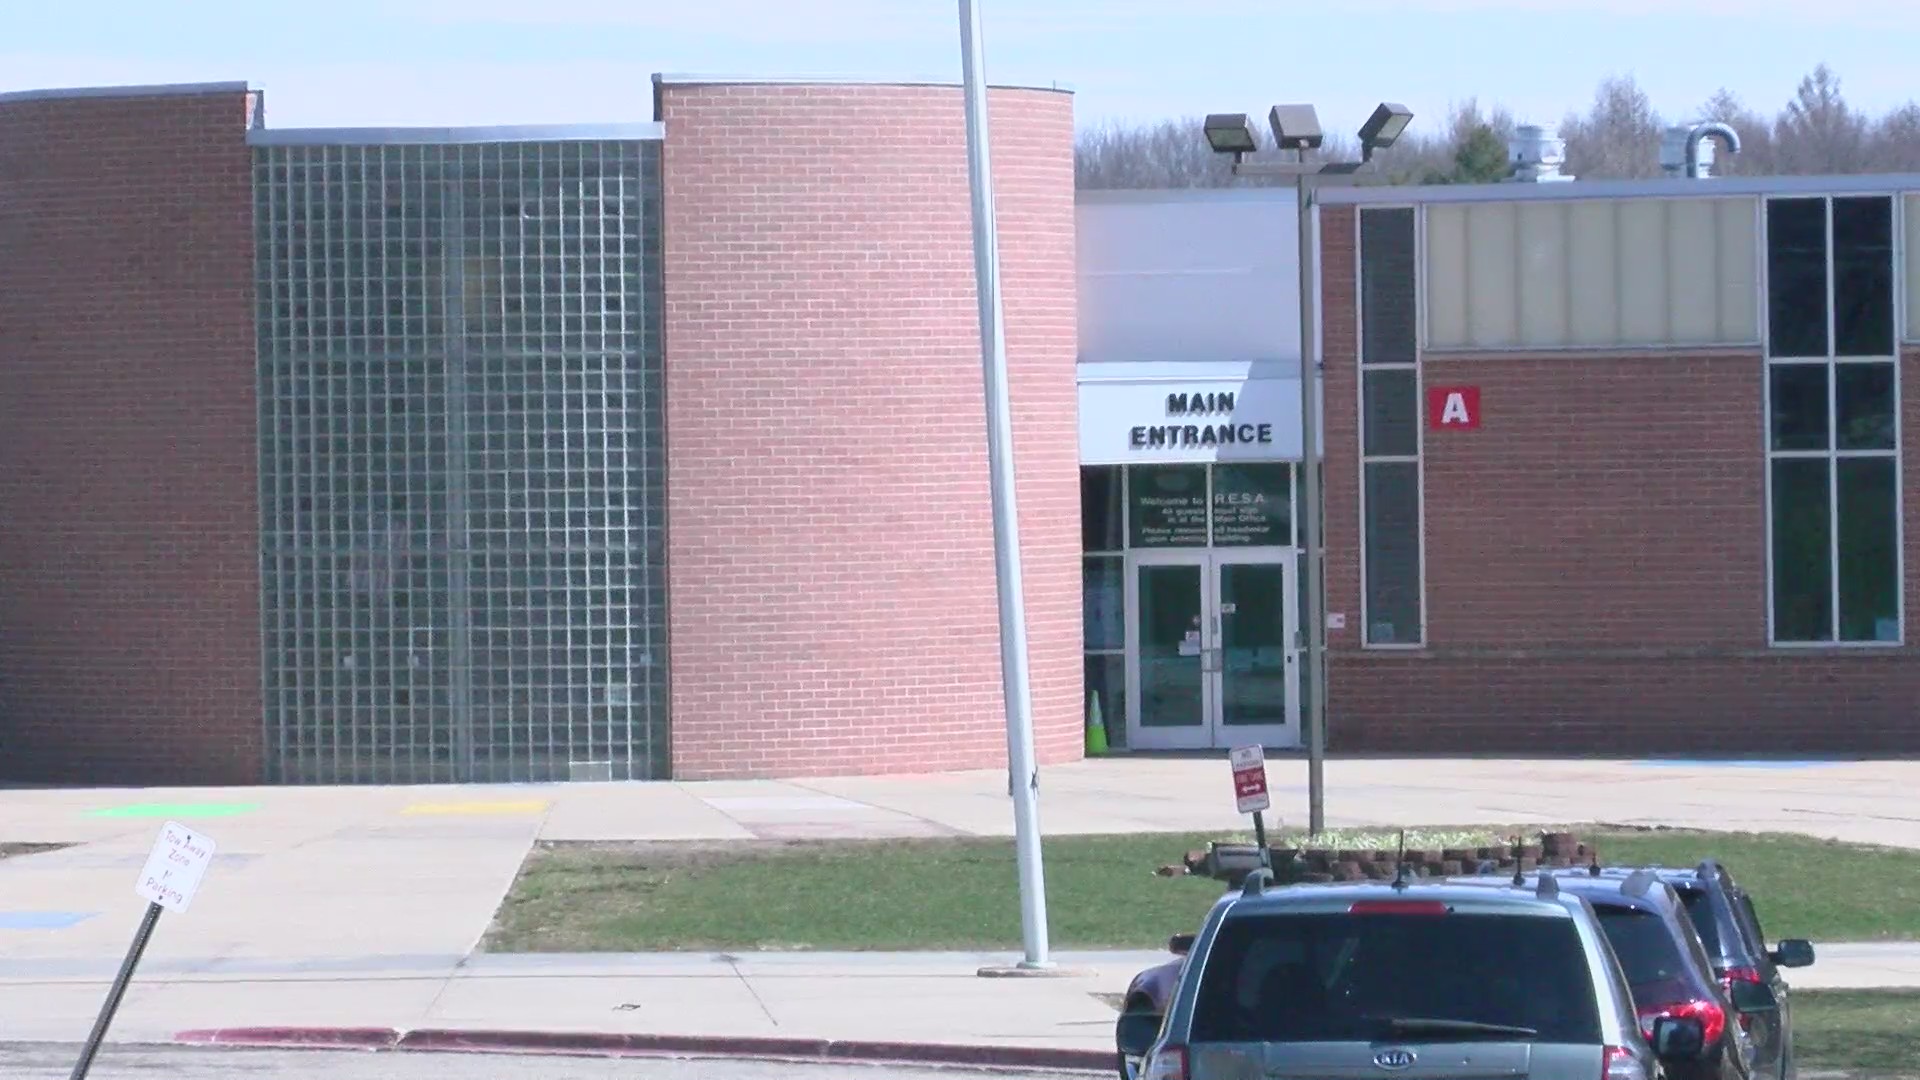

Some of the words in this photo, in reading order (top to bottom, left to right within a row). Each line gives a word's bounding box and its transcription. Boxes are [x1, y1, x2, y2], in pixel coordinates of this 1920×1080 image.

[1168, 392, 1235, 413] MAIN
[1441, 393, 1469, 424] A
[1131, 424, 1273, 446] ENTRANCE
[1140, 497, 1188, 505] Welcome
[1192, 497, 1204, 505] to
[165, 829, 182, 846] Tow
[168, 848, 191, 866] Zone
[146, 876, 183, 904] Parking
